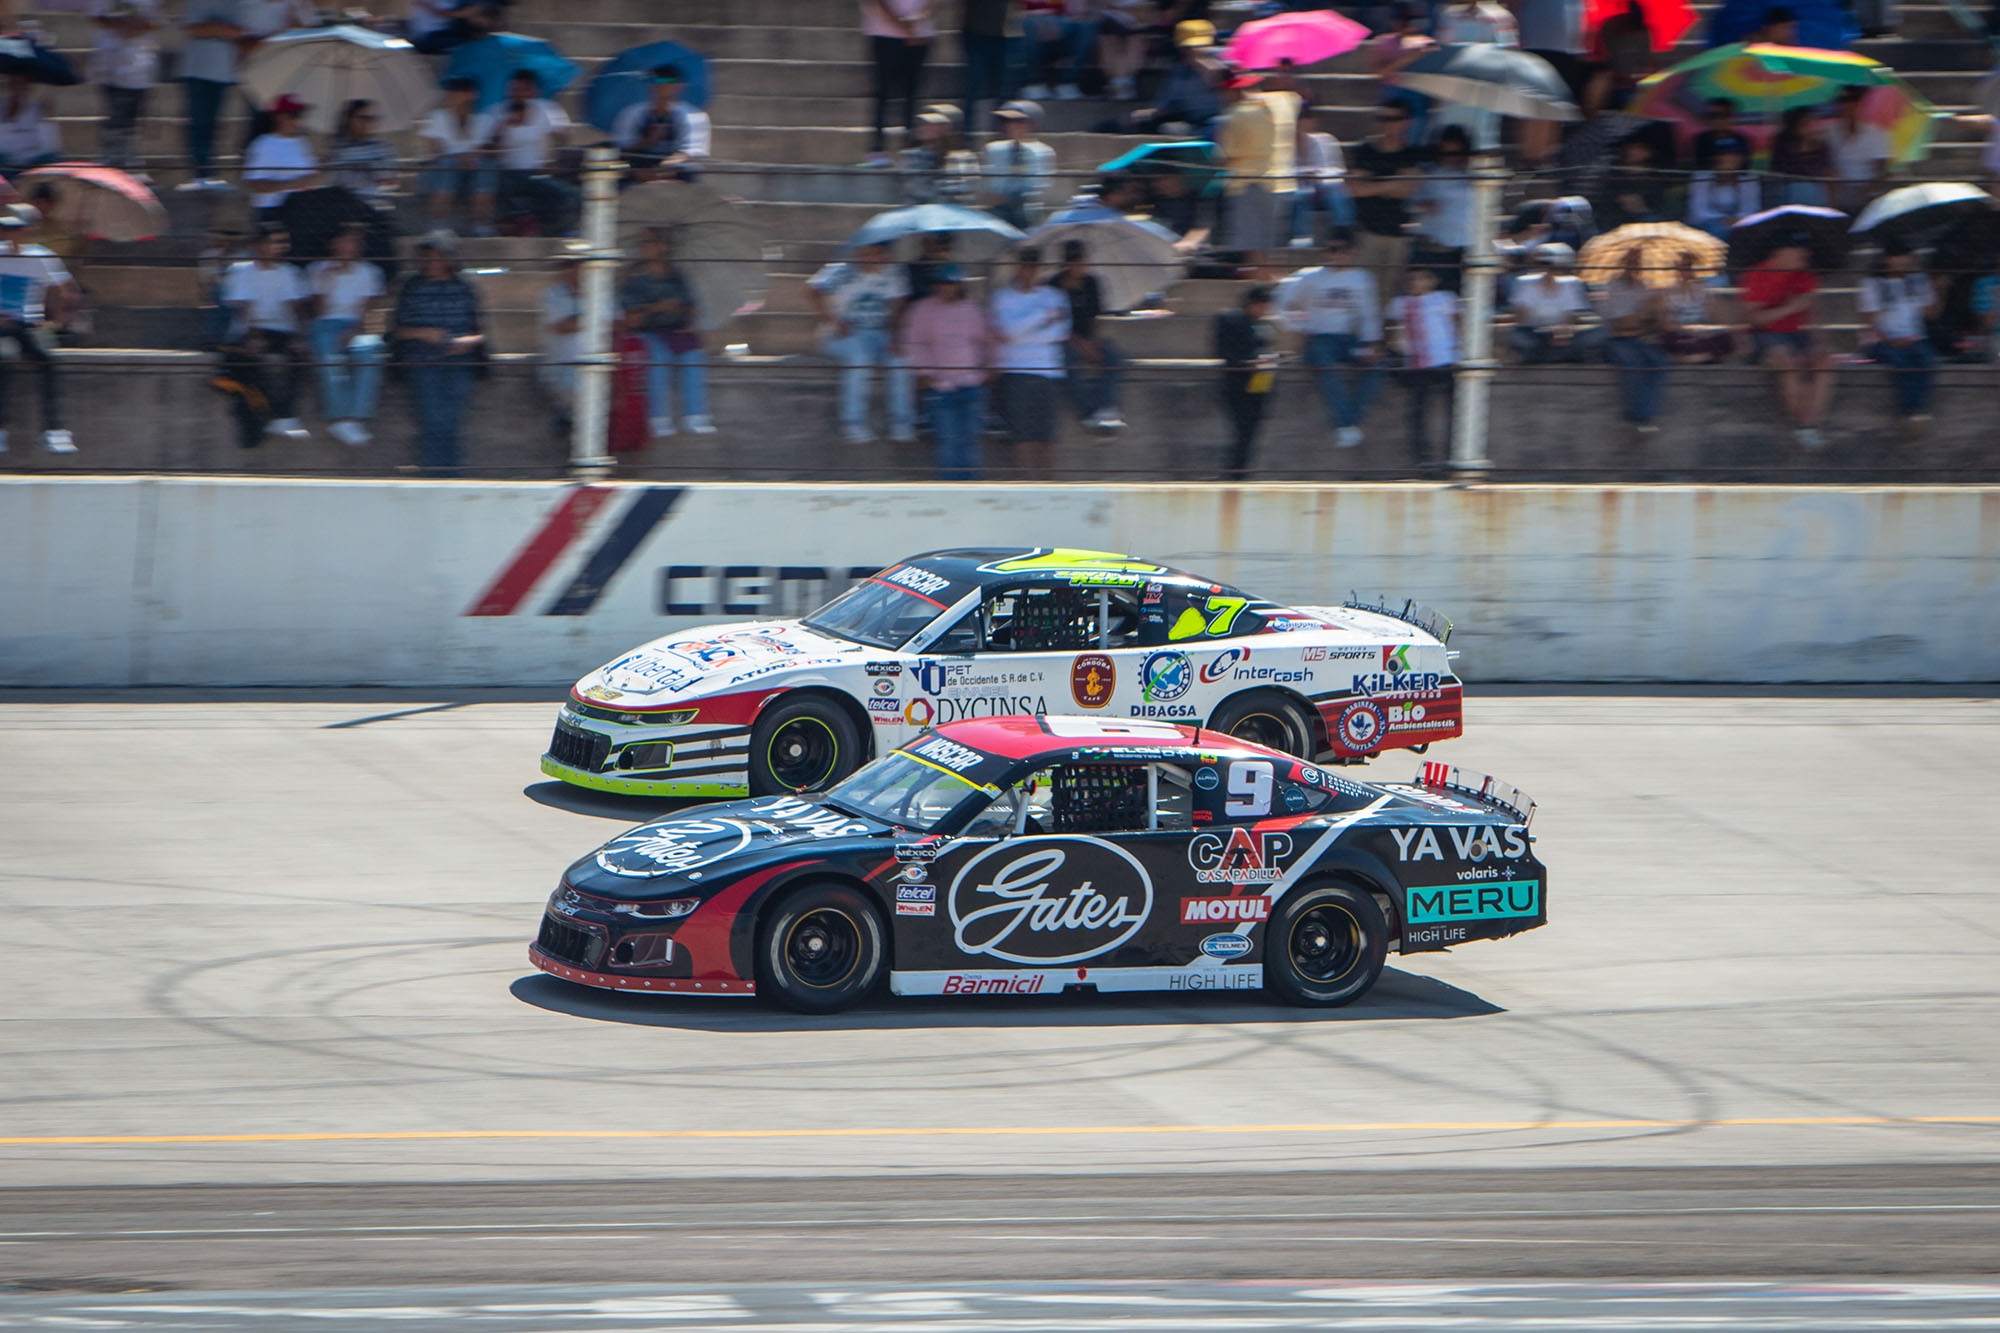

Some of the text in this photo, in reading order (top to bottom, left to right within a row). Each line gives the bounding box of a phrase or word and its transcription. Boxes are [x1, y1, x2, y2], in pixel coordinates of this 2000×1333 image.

[887, 566, 951, 596] NASCAR
[1205, 596, 1249, 637] 7
[1329, 651, 1376, 660] SPORTS
[947, 665, 972, 675] PET
[1234, 667, 1314, 682] Intercash
[947, 676, 957, 686] de
[960, 675, 999, 686] Occidente
[869, 699, 899, 710] telcel
[937, 696, 1048, 725] DYCINSA
[1130, 705, 1197, 717] DIBAGSA
[1388, 720, 1455, 731] Ambientalistik
[914, 738, 984, 772] NASCAR
[1225, 761, 1274, 817] 9
[1188, 828, 1293, 872] CAP
[1390, 826, 1526, 861] YA VAS
[1199, 869, 1283, 881] CASA PADILLA
[1456, 866, 1499, 880] volaris
[899, 887, 934, 899] telcel
[1412, 885, 1533, 917] MERU
[898, 904, 934, 912] WHELEN
[955, 849, 1143, 954] Gates
[1184, 899, 1268, 920] MOTUL
[1408, 928, 1466, 942] HIGH LIFE
[942, 974, 1045, 994] Barmicil
[1169, 973, 1256, 990] HIGH LIFE
